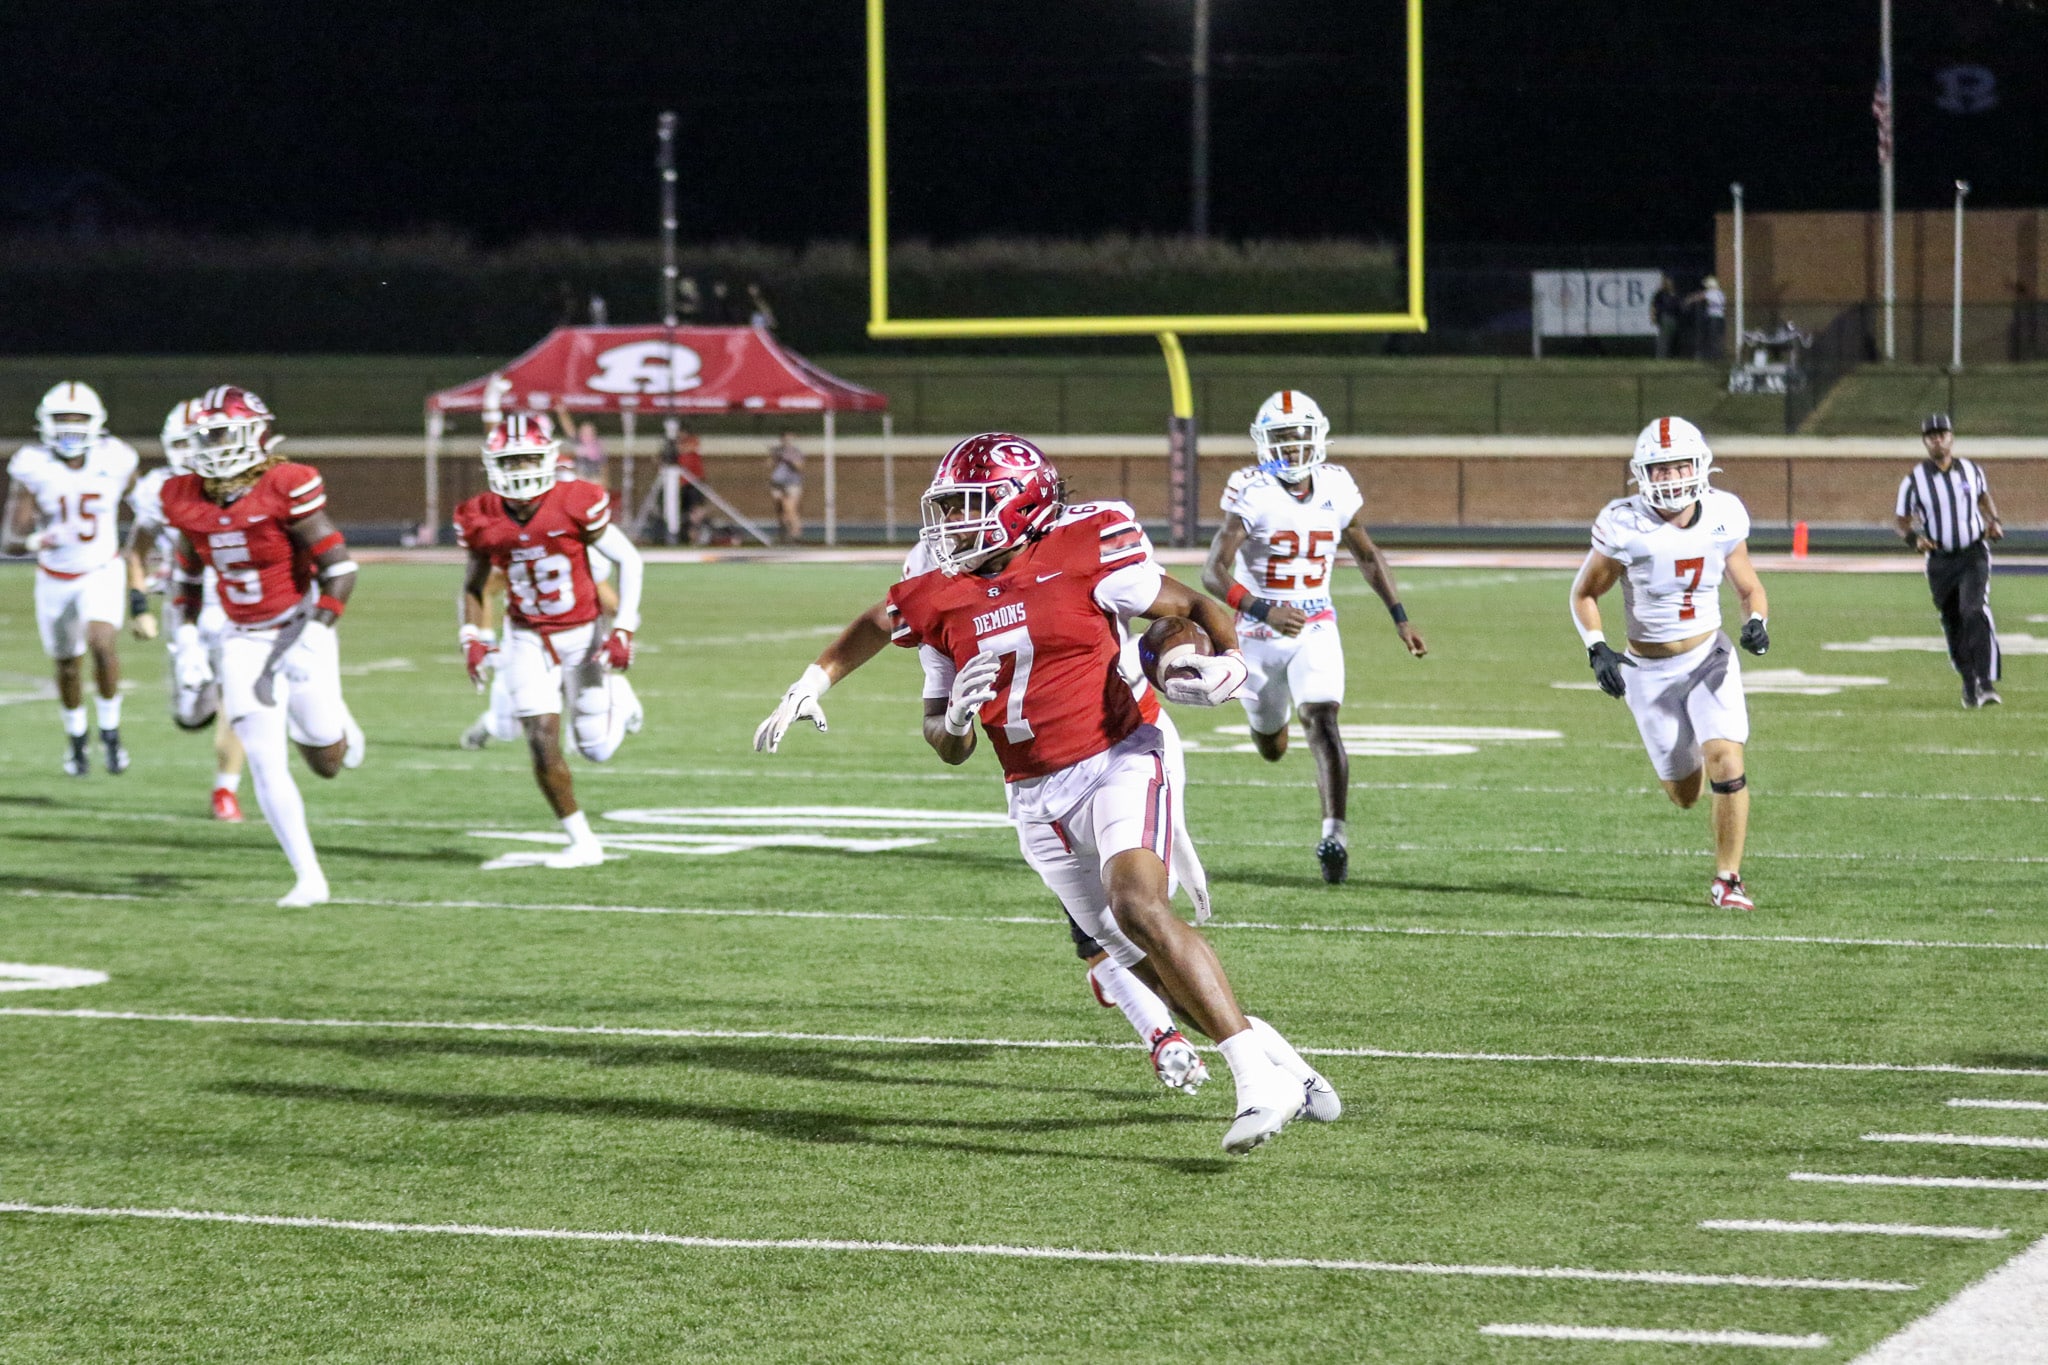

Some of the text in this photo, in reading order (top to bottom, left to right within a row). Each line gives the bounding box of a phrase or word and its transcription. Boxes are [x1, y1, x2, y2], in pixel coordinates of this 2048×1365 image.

[586, 340, 701, 395] R
[58, 493, 102, 542] 15
[212, 547, 264, 605] 5
[1265, 530, 1334, 589] 25
[1674, 556, 1705, 622] 7
[972, 601, 1027, 636] DEMONS
[976, 625, 1036, 745] 7
